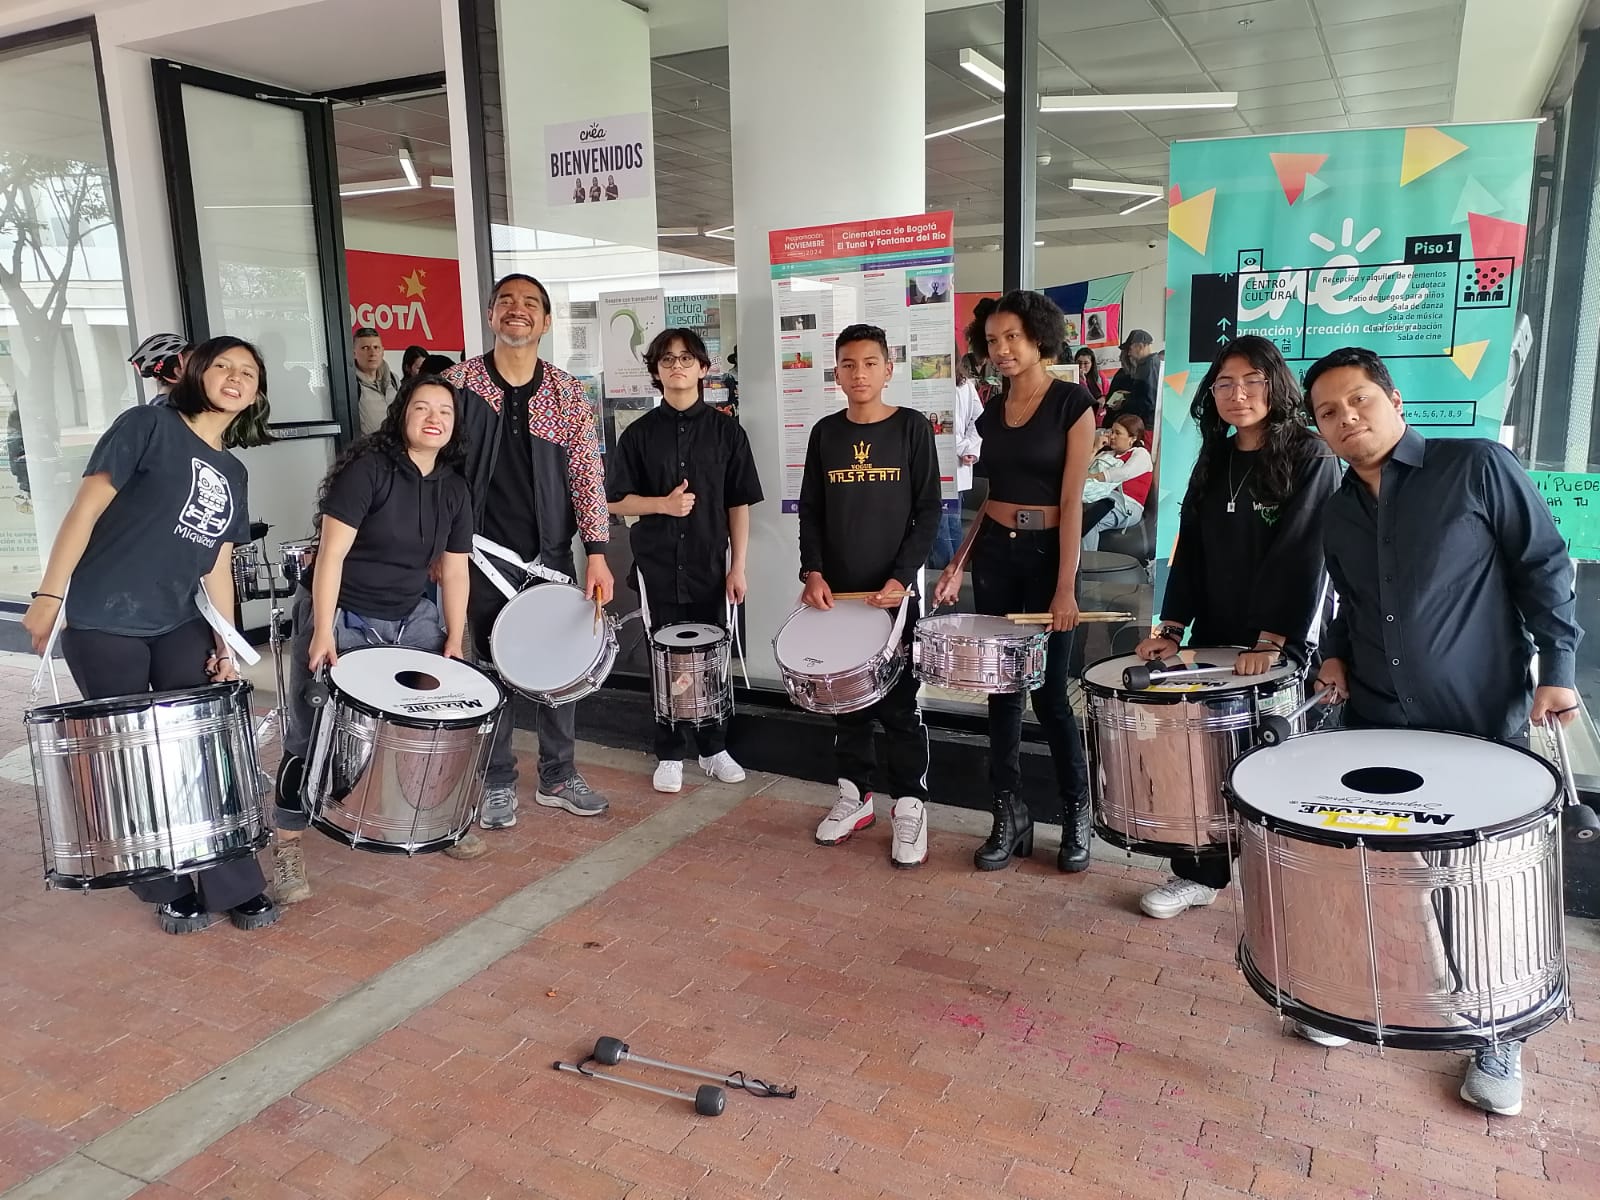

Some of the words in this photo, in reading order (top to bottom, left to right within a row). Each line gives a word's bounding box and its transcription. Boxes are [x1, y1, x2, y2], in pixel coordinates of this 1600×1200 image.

[550, 142, 643, 178] BIENVENIDOS
[842, 228, 892, 240] Cinemateca
[894, 226, 905, 235] de
[906, 222, 937, 235] Bogotá
[784, 239, 825, 251] NOVIEMBRE
[837, 242, 844, 250] El
[845, 240, 868, 250] Tunal
[869, 240, 875, 249] y
[876, 236, 915, 246] Fontanar
[916, 233, 931, 242] del
[933, 231, 946, 240] Río
[1414, 241, 1444, 255] Piso
[1446, 240, 1454, 253] 1
[1322, 274, 1359, 284] Recepción
[1366, 272, 1395, 282] alquiler
[1396, 272, 1406, 280] de
[1407, 270, 1447, 279] elementos
[1245, 278, 1286, 290] CENTRO
[1411, 281, 1446, 289] Ludoteca
[1244, 290, 1298, 302] CULTURAL
[1348, 294, 1368, 302] Patio
[1368, 293, 1378, 302] de
[1405, 293, 1422, 303] para
[1424, 291, 1445, 299] niños
[668, 303, 702, 315] Lectura
[1410, 302, 1420, 310] de
[1421, 301, 1444, 309] danza
[1388, 313, 1404, 321] Sala
[1405, 312, 1415, 320] de
[1416, 311, 1443, 319] música
[1237, 325, 1292, 337] ormación
[1305, 323, 1360, 335] creación
[1397, 333, 1414, 341] Sala
[1425, 332, 1442, 340] cine
[1573, 497, 1588, 506] TU
